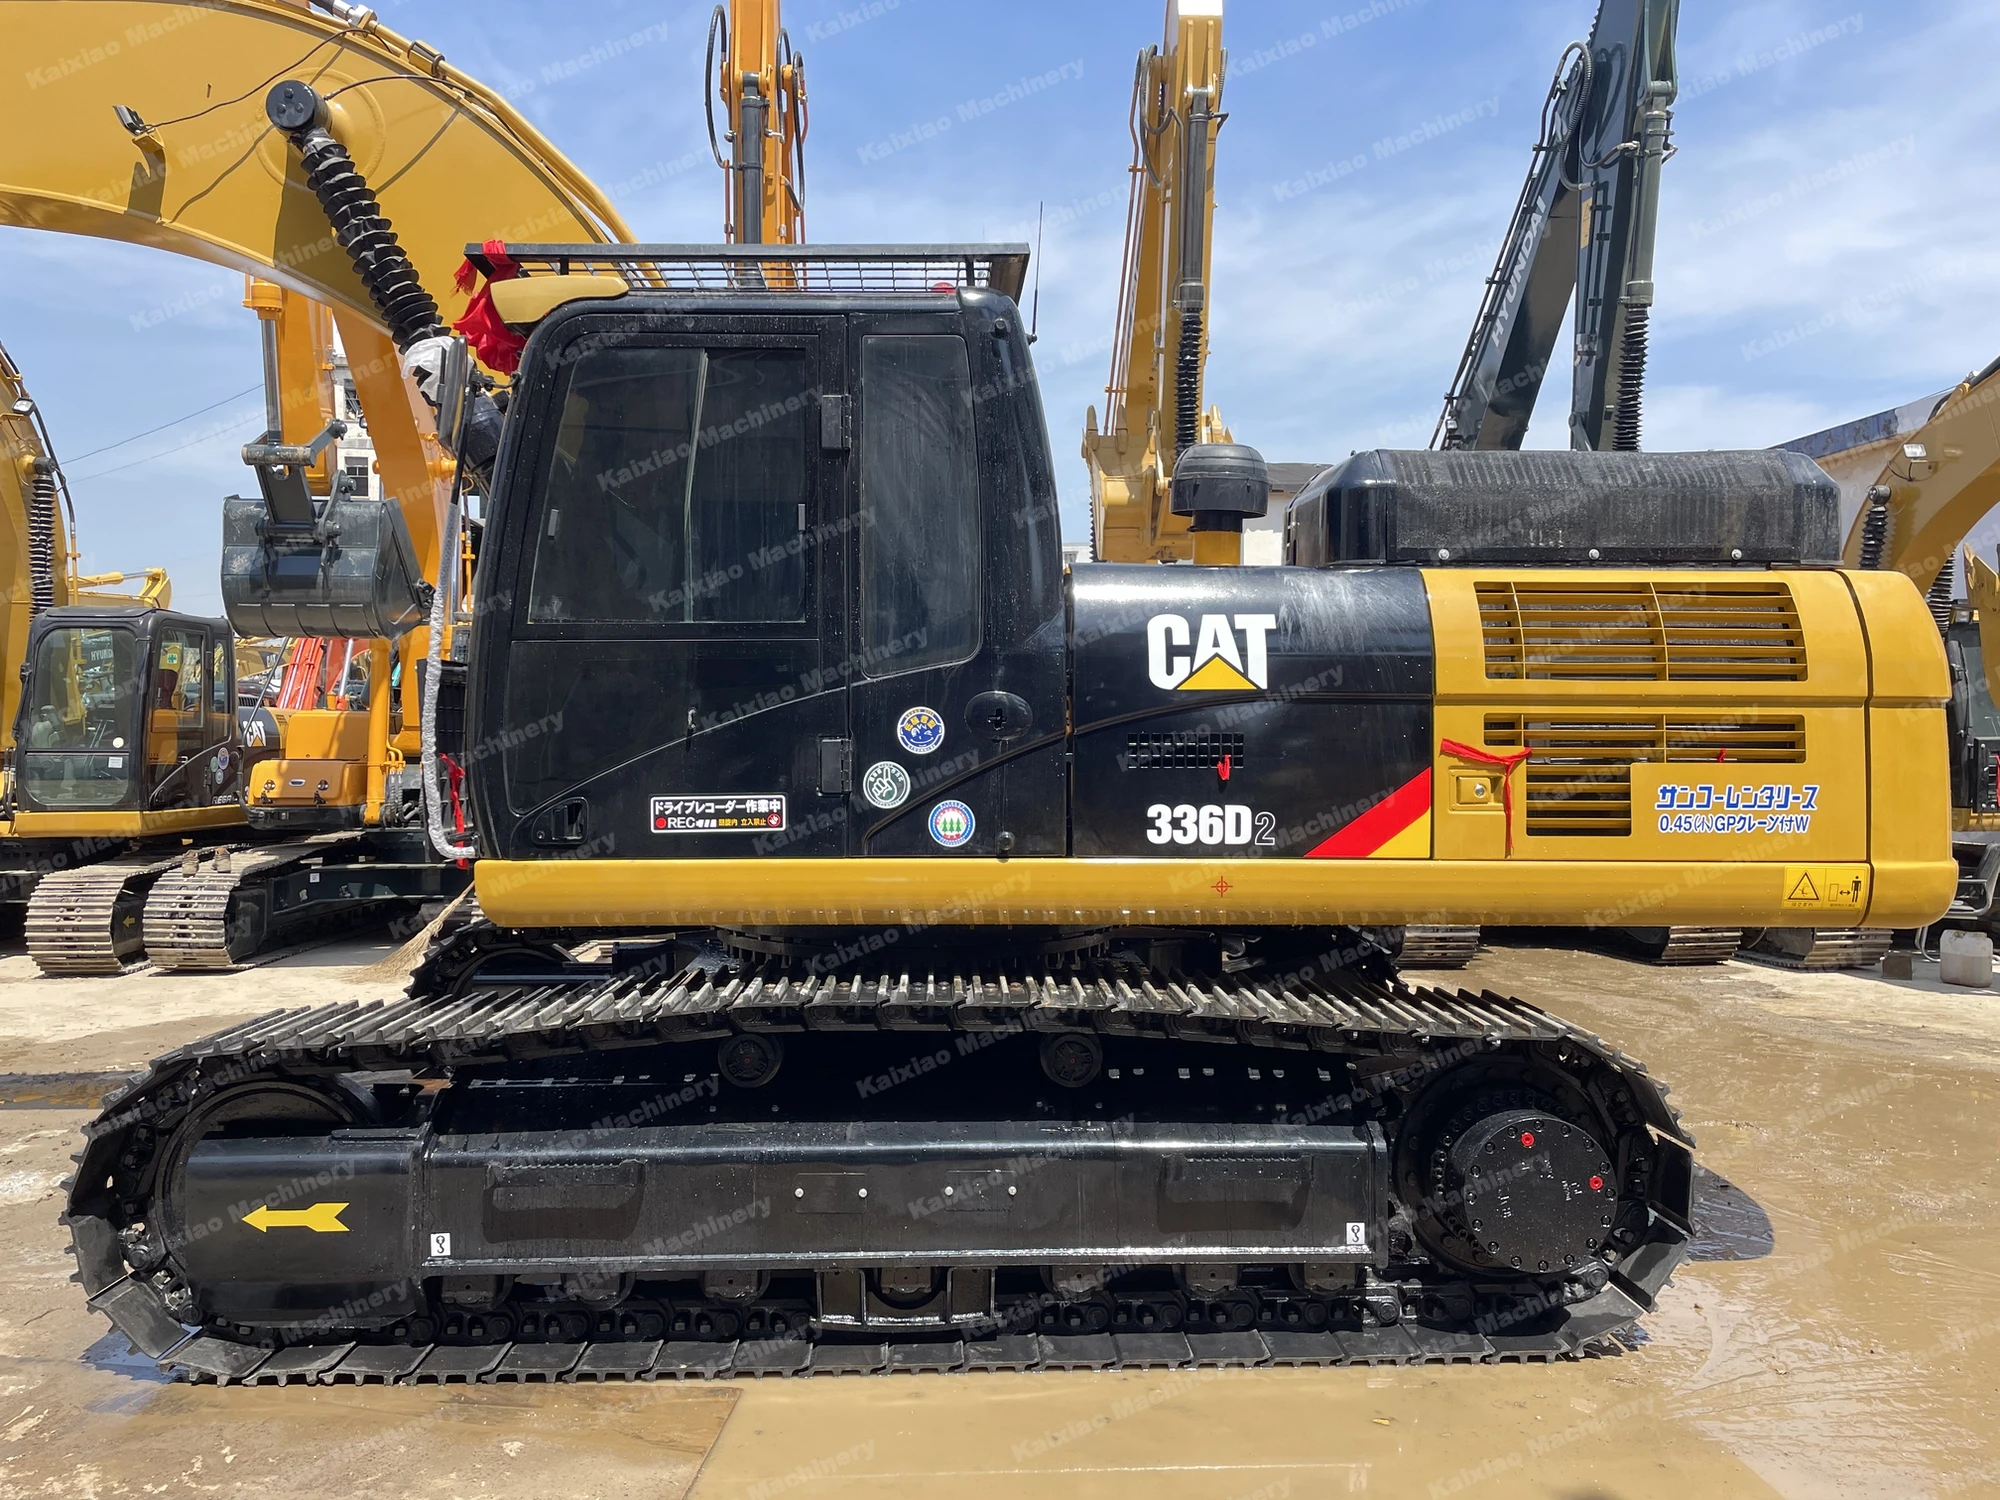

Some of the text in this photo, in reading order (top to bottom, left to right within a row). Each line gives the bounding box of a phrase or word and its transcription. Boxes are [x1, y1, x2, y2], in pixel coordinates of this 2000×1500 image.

[1491, 195, 1547, 347] HYUNDAI
[1147, 613, 1277, 690] CAT
[655, 799, 781, 815] ドライブレコーダー作業中
[1655, 785, 1819, 809] サンコーレンタリース
[667, 817, 695, 828] REC
